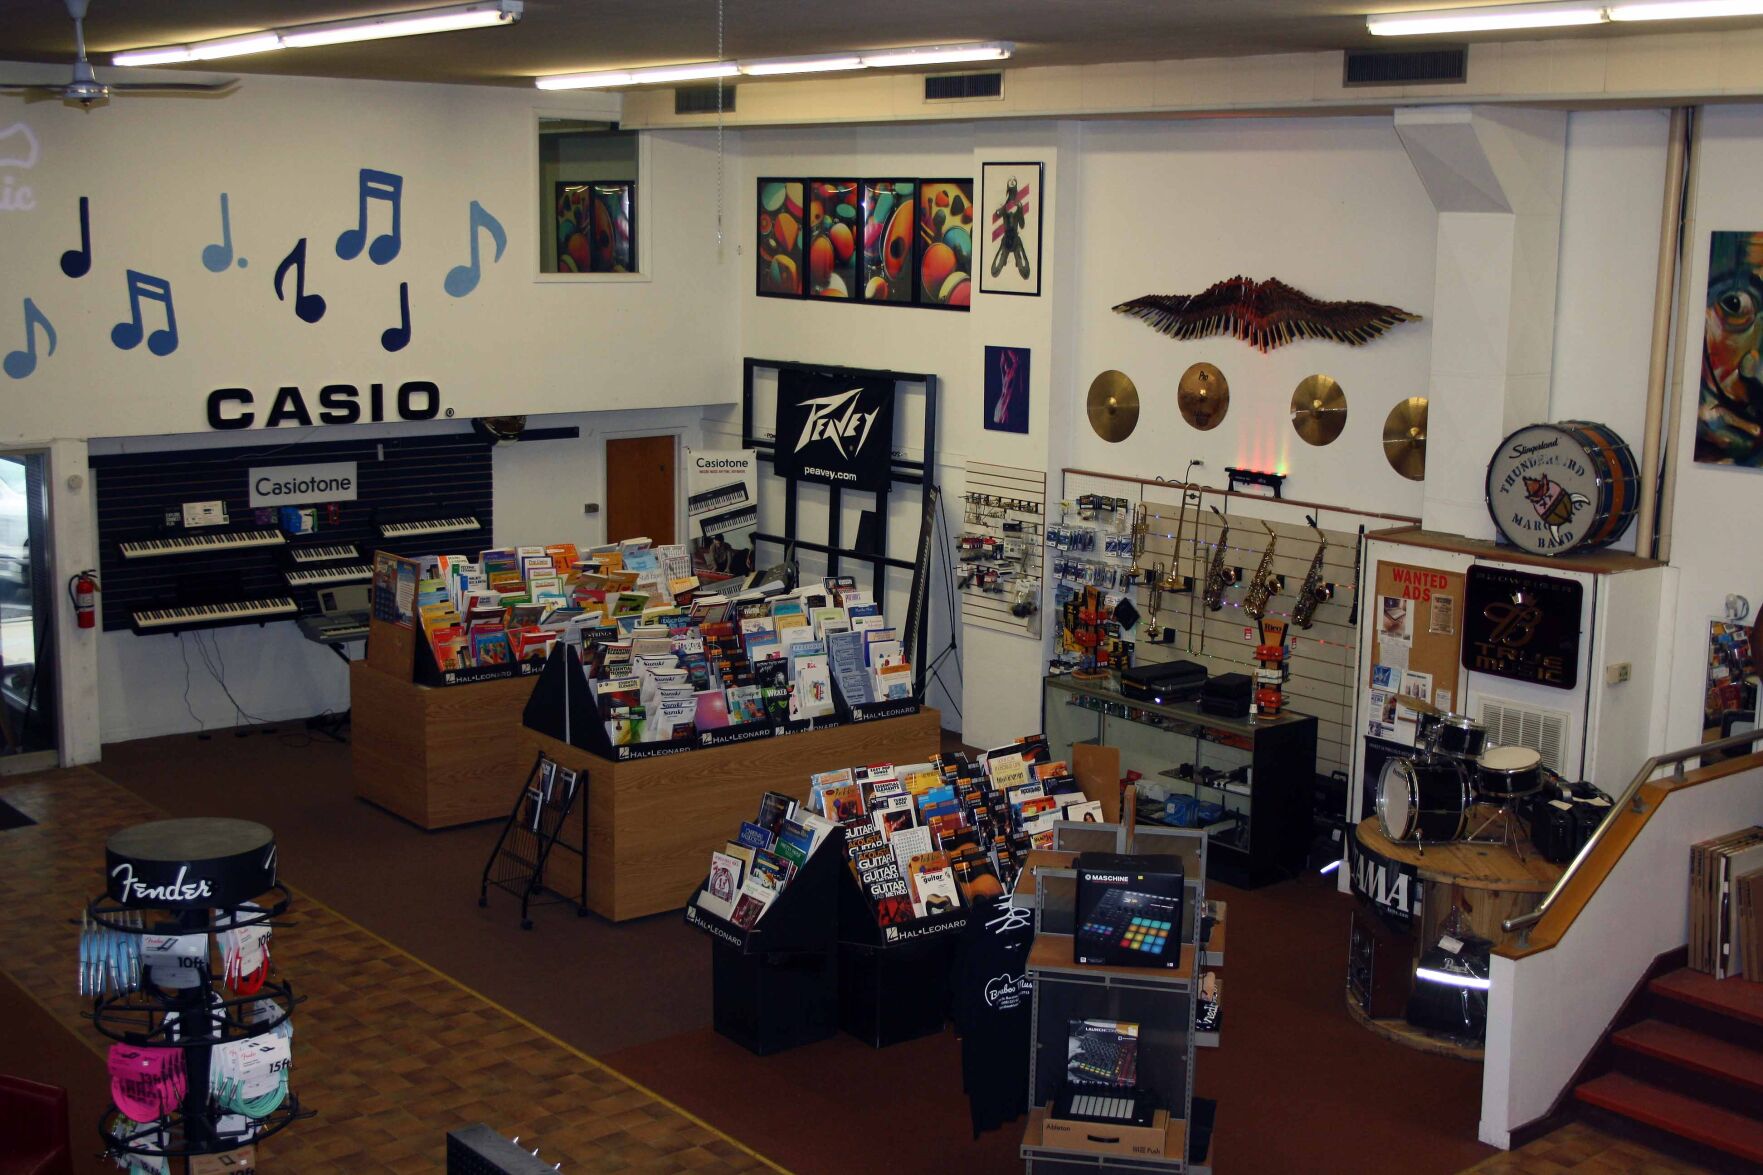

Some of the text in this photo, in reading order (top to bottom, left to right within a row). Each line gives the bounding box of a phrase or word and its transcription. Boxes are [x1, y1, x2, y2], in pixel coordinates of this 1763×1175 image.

[206, 380, 441, 431] CASIO
[793, 387, 881, 461] PEAVEY
[1508, 437, 1559, 459] Slingerland
[696, 457, 749, 468] Casiotone
[804, 466, 857, 481] peavey.com
[255, 476, 352, 497] Casiotone
[1393, 567, 1448, 590] WANTED
[1402, 585, 1431, 602] ADS
[858, 854, 892, 870] GUITAR
[863, 864, 898, 884] GUITAR
[923, 873, 943, 884] guitar
[1092, 874, 1129, 883] MASCHINE
[112, 862, 213, 904] Fender
[870, 880, 907, 895] GUITAR
[885, 888, 908, 898] METHOD
[177, 956, 204, 969] 10ft
[269, 1058, 290, 1073] 15ft
[1046, 1122, 1071, 1132] Ableton
[1146, 1146, 1161, 1155] Push
